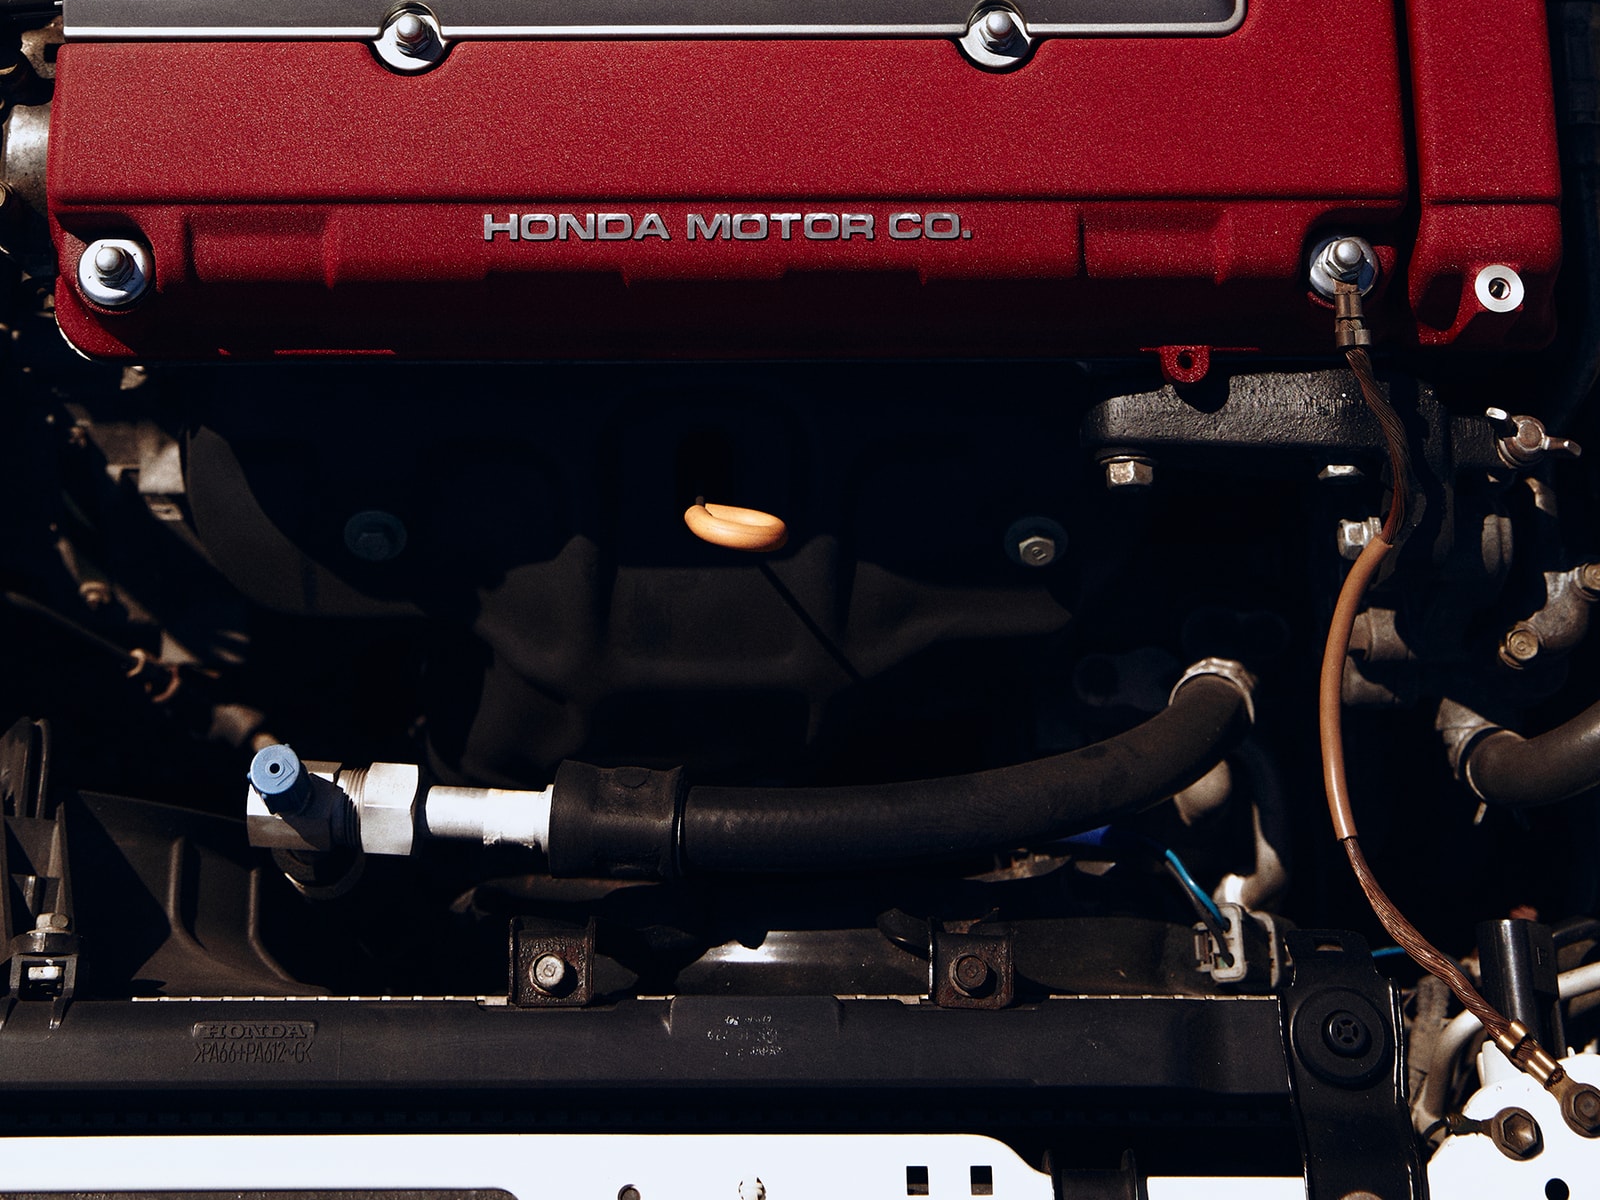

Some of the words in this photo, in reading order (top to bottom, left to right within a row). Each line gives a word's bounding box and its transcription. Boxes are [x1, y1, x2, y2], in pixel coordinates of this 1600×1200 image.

[483, 213, 670, 240] HONDA
[687, 213, 874, 239] MOTOR
[888, 212, 972, 239] CO.
[202, 1023, 308, 1040] HONDA
